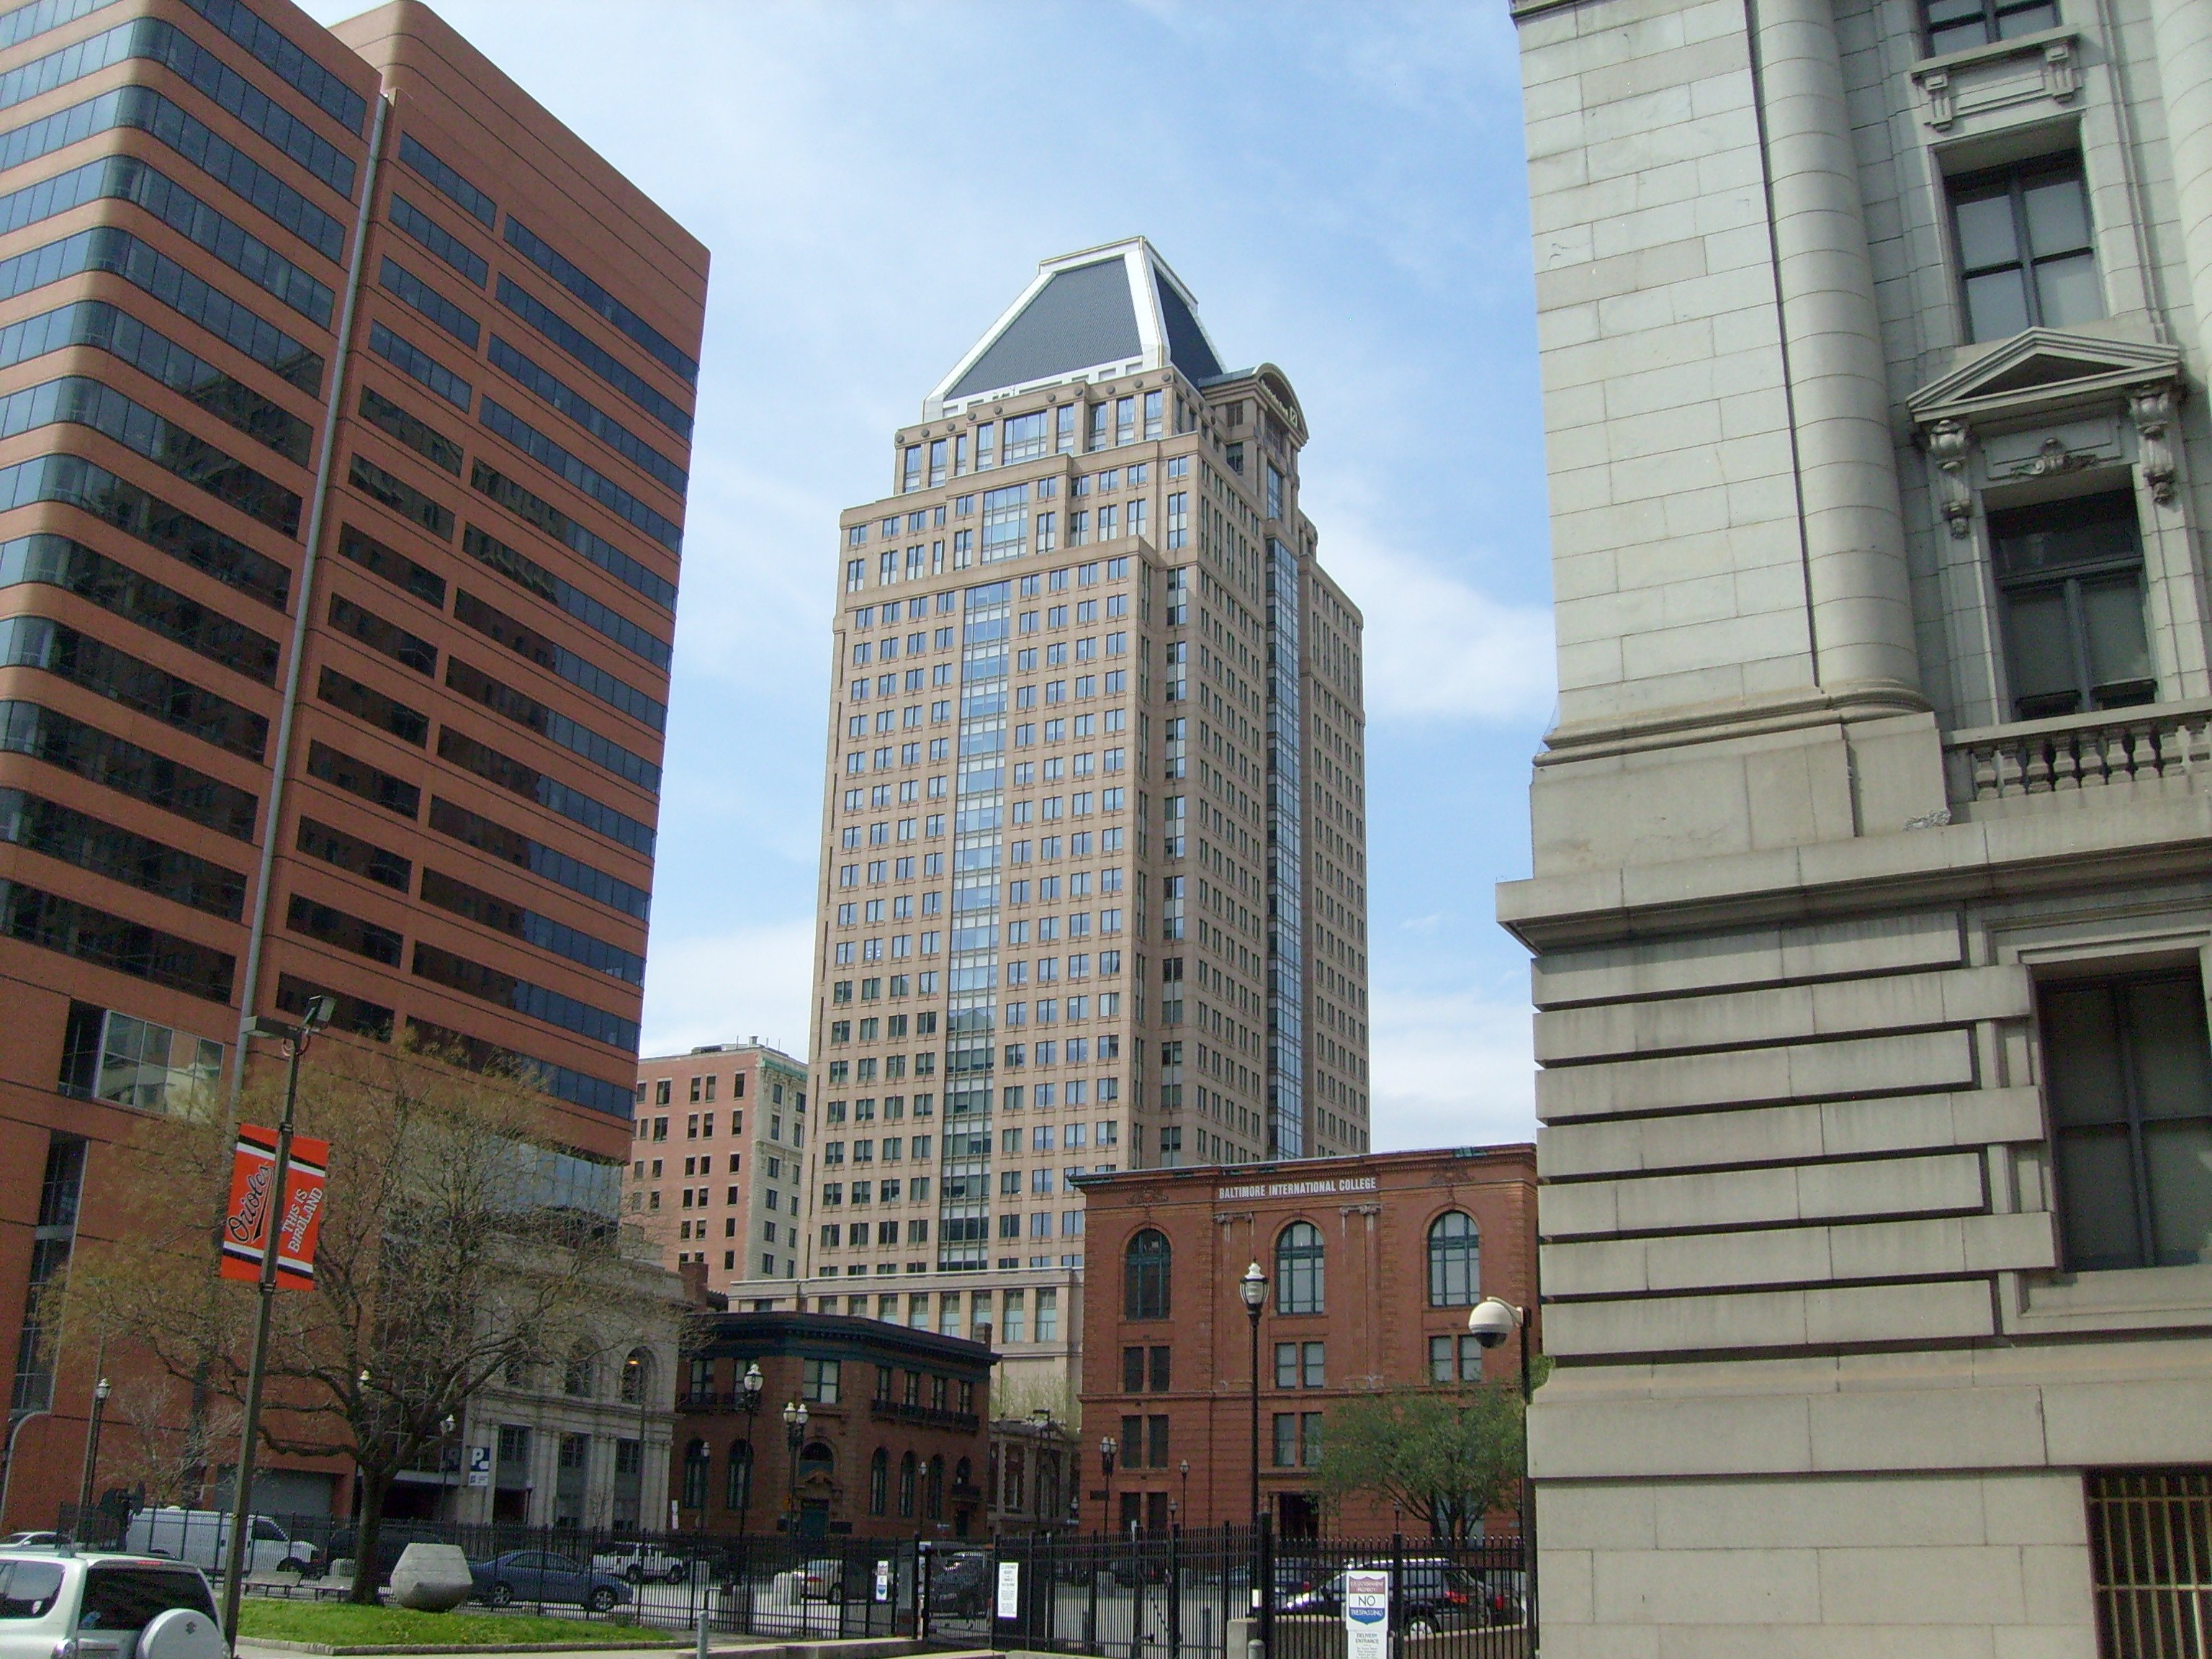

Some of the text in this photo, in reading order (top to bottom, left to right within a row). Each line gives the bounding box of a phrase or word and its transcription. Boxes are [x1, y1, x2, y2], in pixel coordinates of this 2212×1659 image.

[227, 1162, 273, 1244] Orioles
[282, 1188, 309, 1233] THIS IS
[1219, 1177, 1376, 1199] BALTIMORE INTERNATIONAL COLLEGE
[288, 1187, 323, 1254] BIRDLAND
[1358, 1596, 1376, 1606] NO
